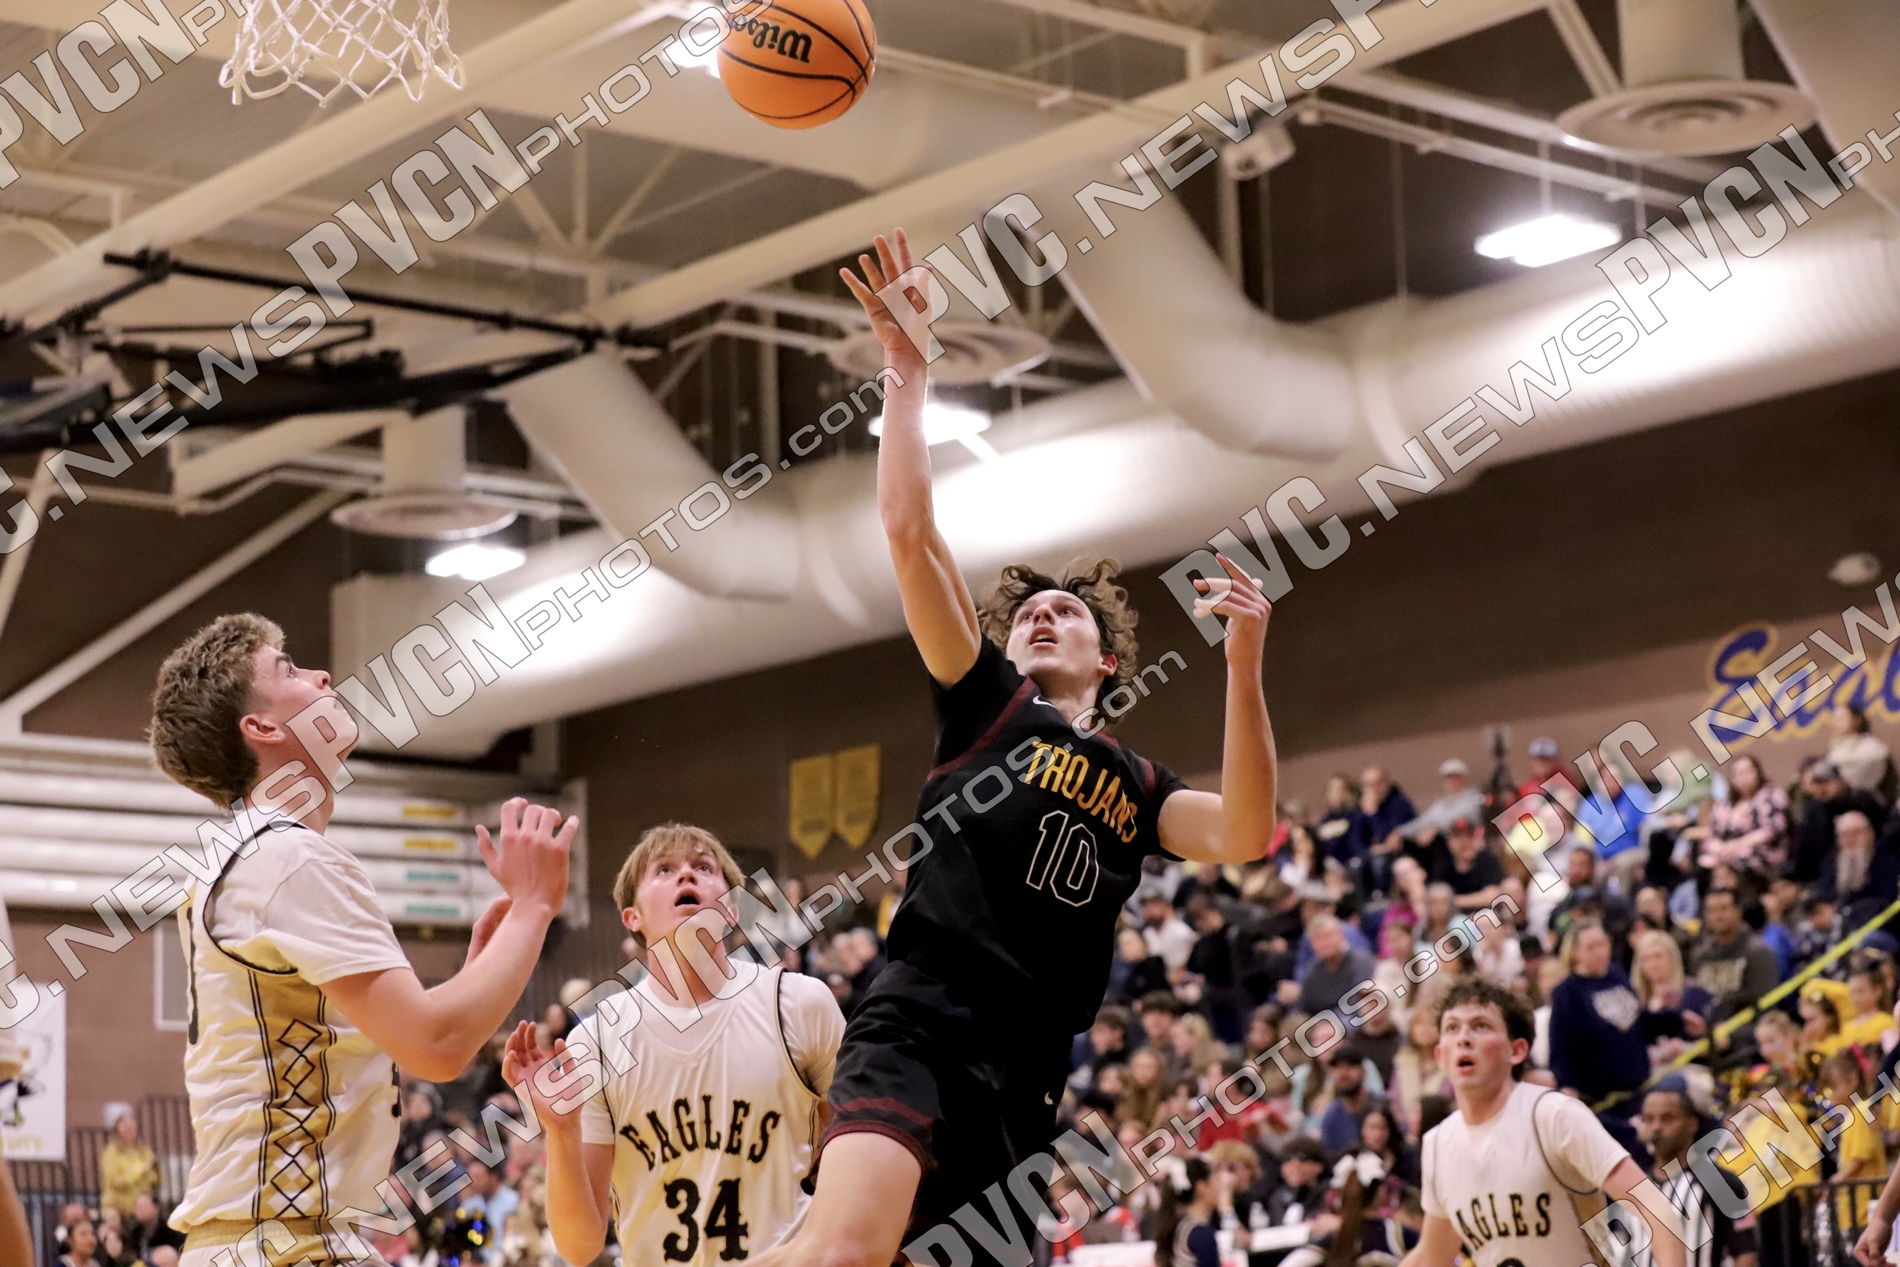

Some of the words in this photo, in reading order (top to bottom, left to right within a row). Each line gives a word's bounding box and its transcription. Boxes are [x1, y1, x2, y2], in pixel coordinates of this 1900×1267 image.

[1024, 740, 1138, 843] TROJANS
[1026, 809, 1100, 907] 10
[619, 1094, 782, 1171] EAGLES
[663, 1177, 749, 1263] 34
[1456, 1192, 1552, 1257] AGLES
